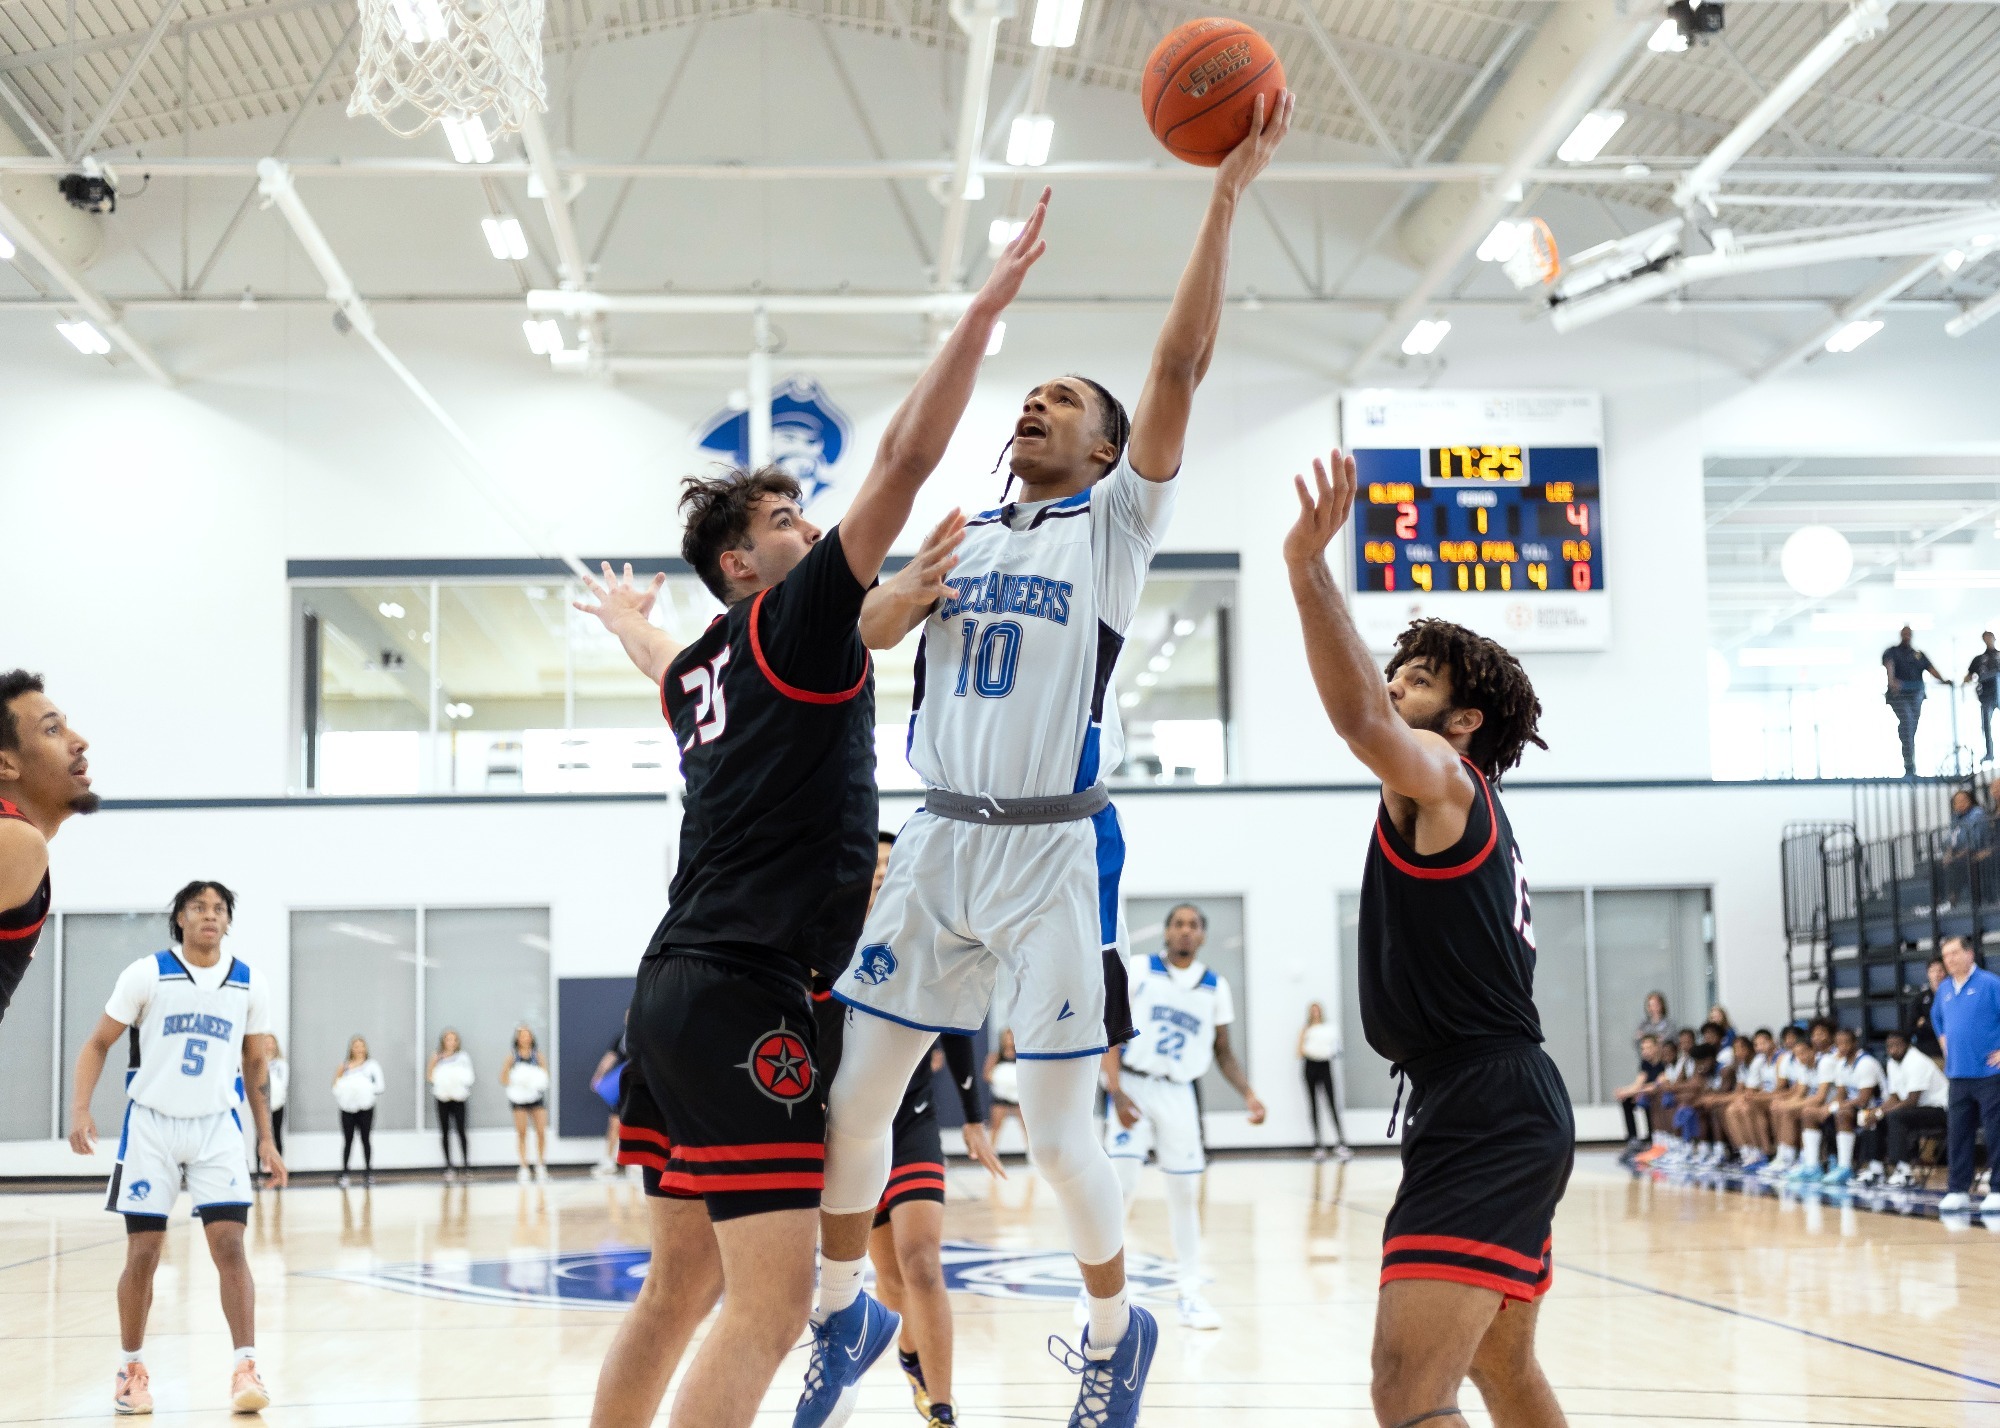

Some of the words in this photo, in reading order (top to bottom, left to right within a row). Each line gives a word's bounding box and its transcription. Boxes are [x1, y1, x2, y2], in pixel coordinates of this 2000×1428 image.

[1177, 40, 1251, 95] LEGACY
[1440, 444, 1523, 481] 17:25
[1395, 501, 1418, 540] 2
[1476, 506, 1488, 534] 1
[1566, 503, 1589, 536] 4
[1384, 563, 1395, 592] 1
[1571, 560, 1592, 593] 0
[954, 618, 1023, 699] 10
[181, 1037, 208, 1076] 5
